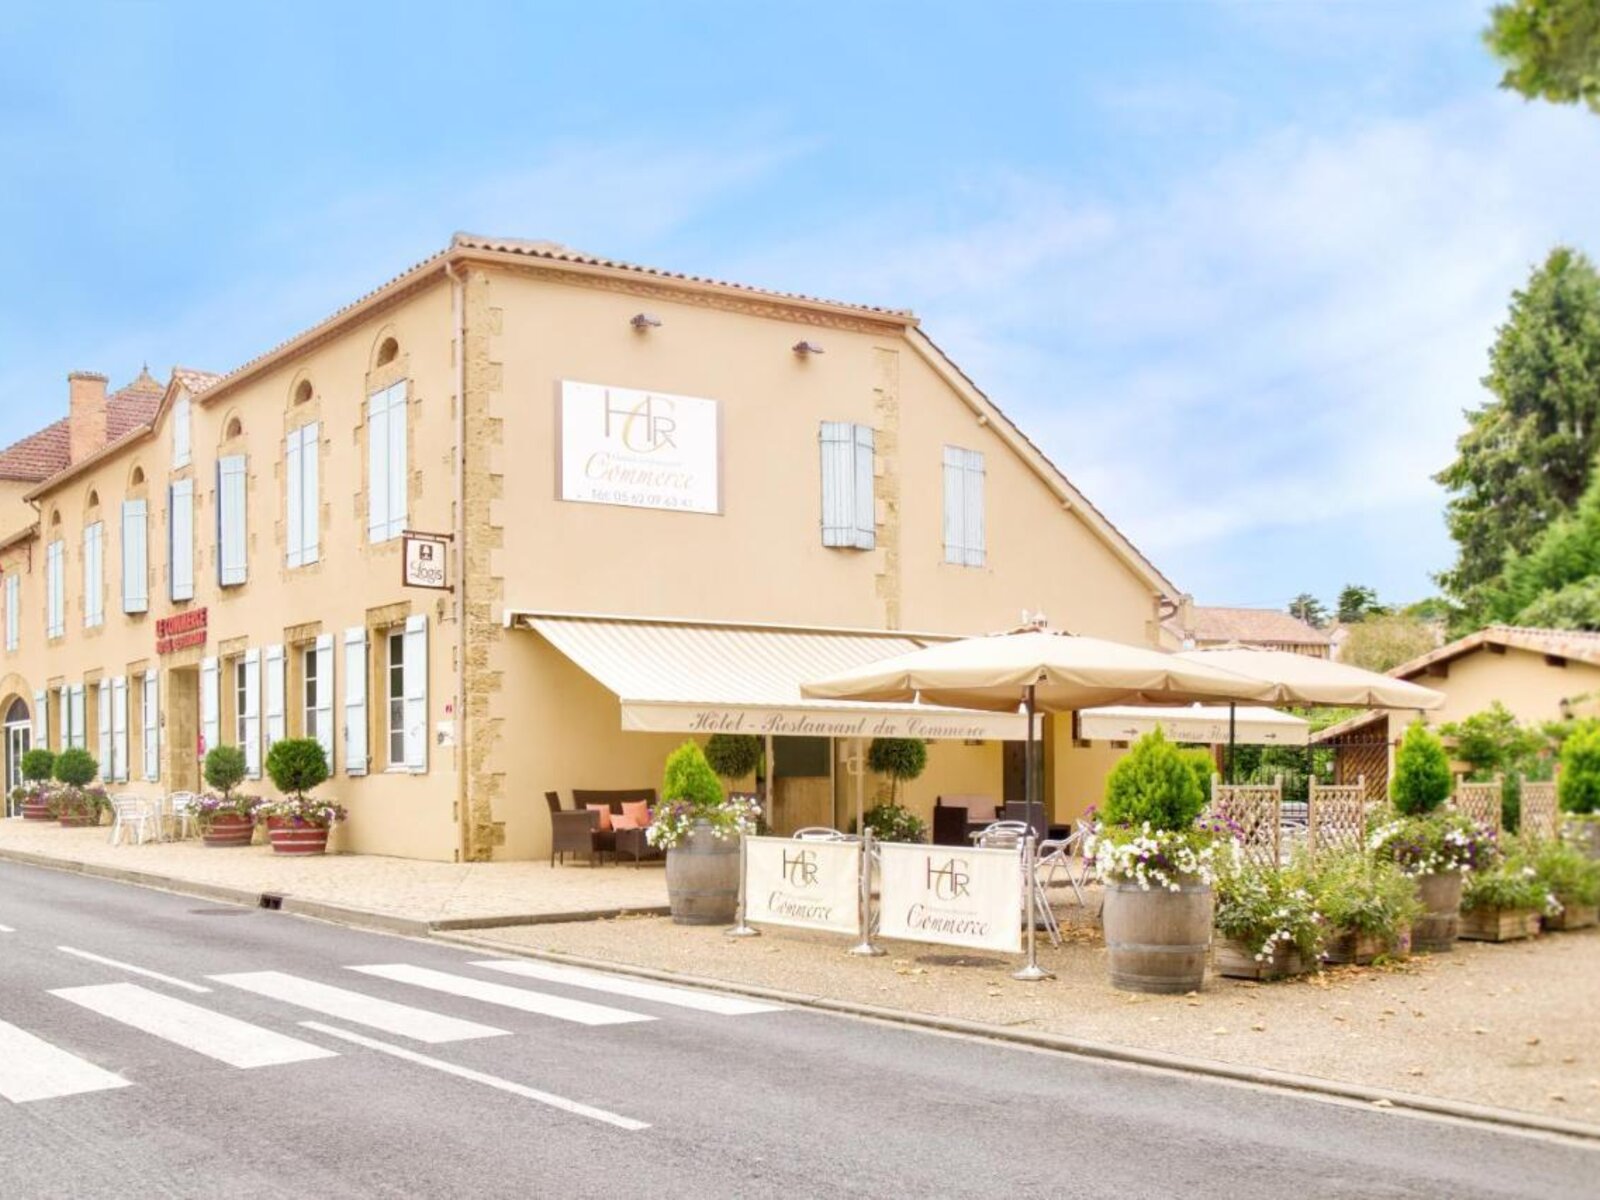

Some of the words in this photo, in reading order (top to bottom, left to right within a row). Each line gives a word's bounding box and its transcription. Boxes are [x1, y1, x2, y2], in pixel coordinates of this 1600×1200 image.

[585, 452, 692, 489] Commerce
[410, 561, 442, 584] Logis
[689, 710, 745, 731] Hôtel
[761, 711, 867, 734] Restaurant
[873, 717, 896, 735] du
[907, 717, 986, 736] Commerce
[768, 890, 832, 920] Commerce
[906, 903, 989, 936] Commerce
